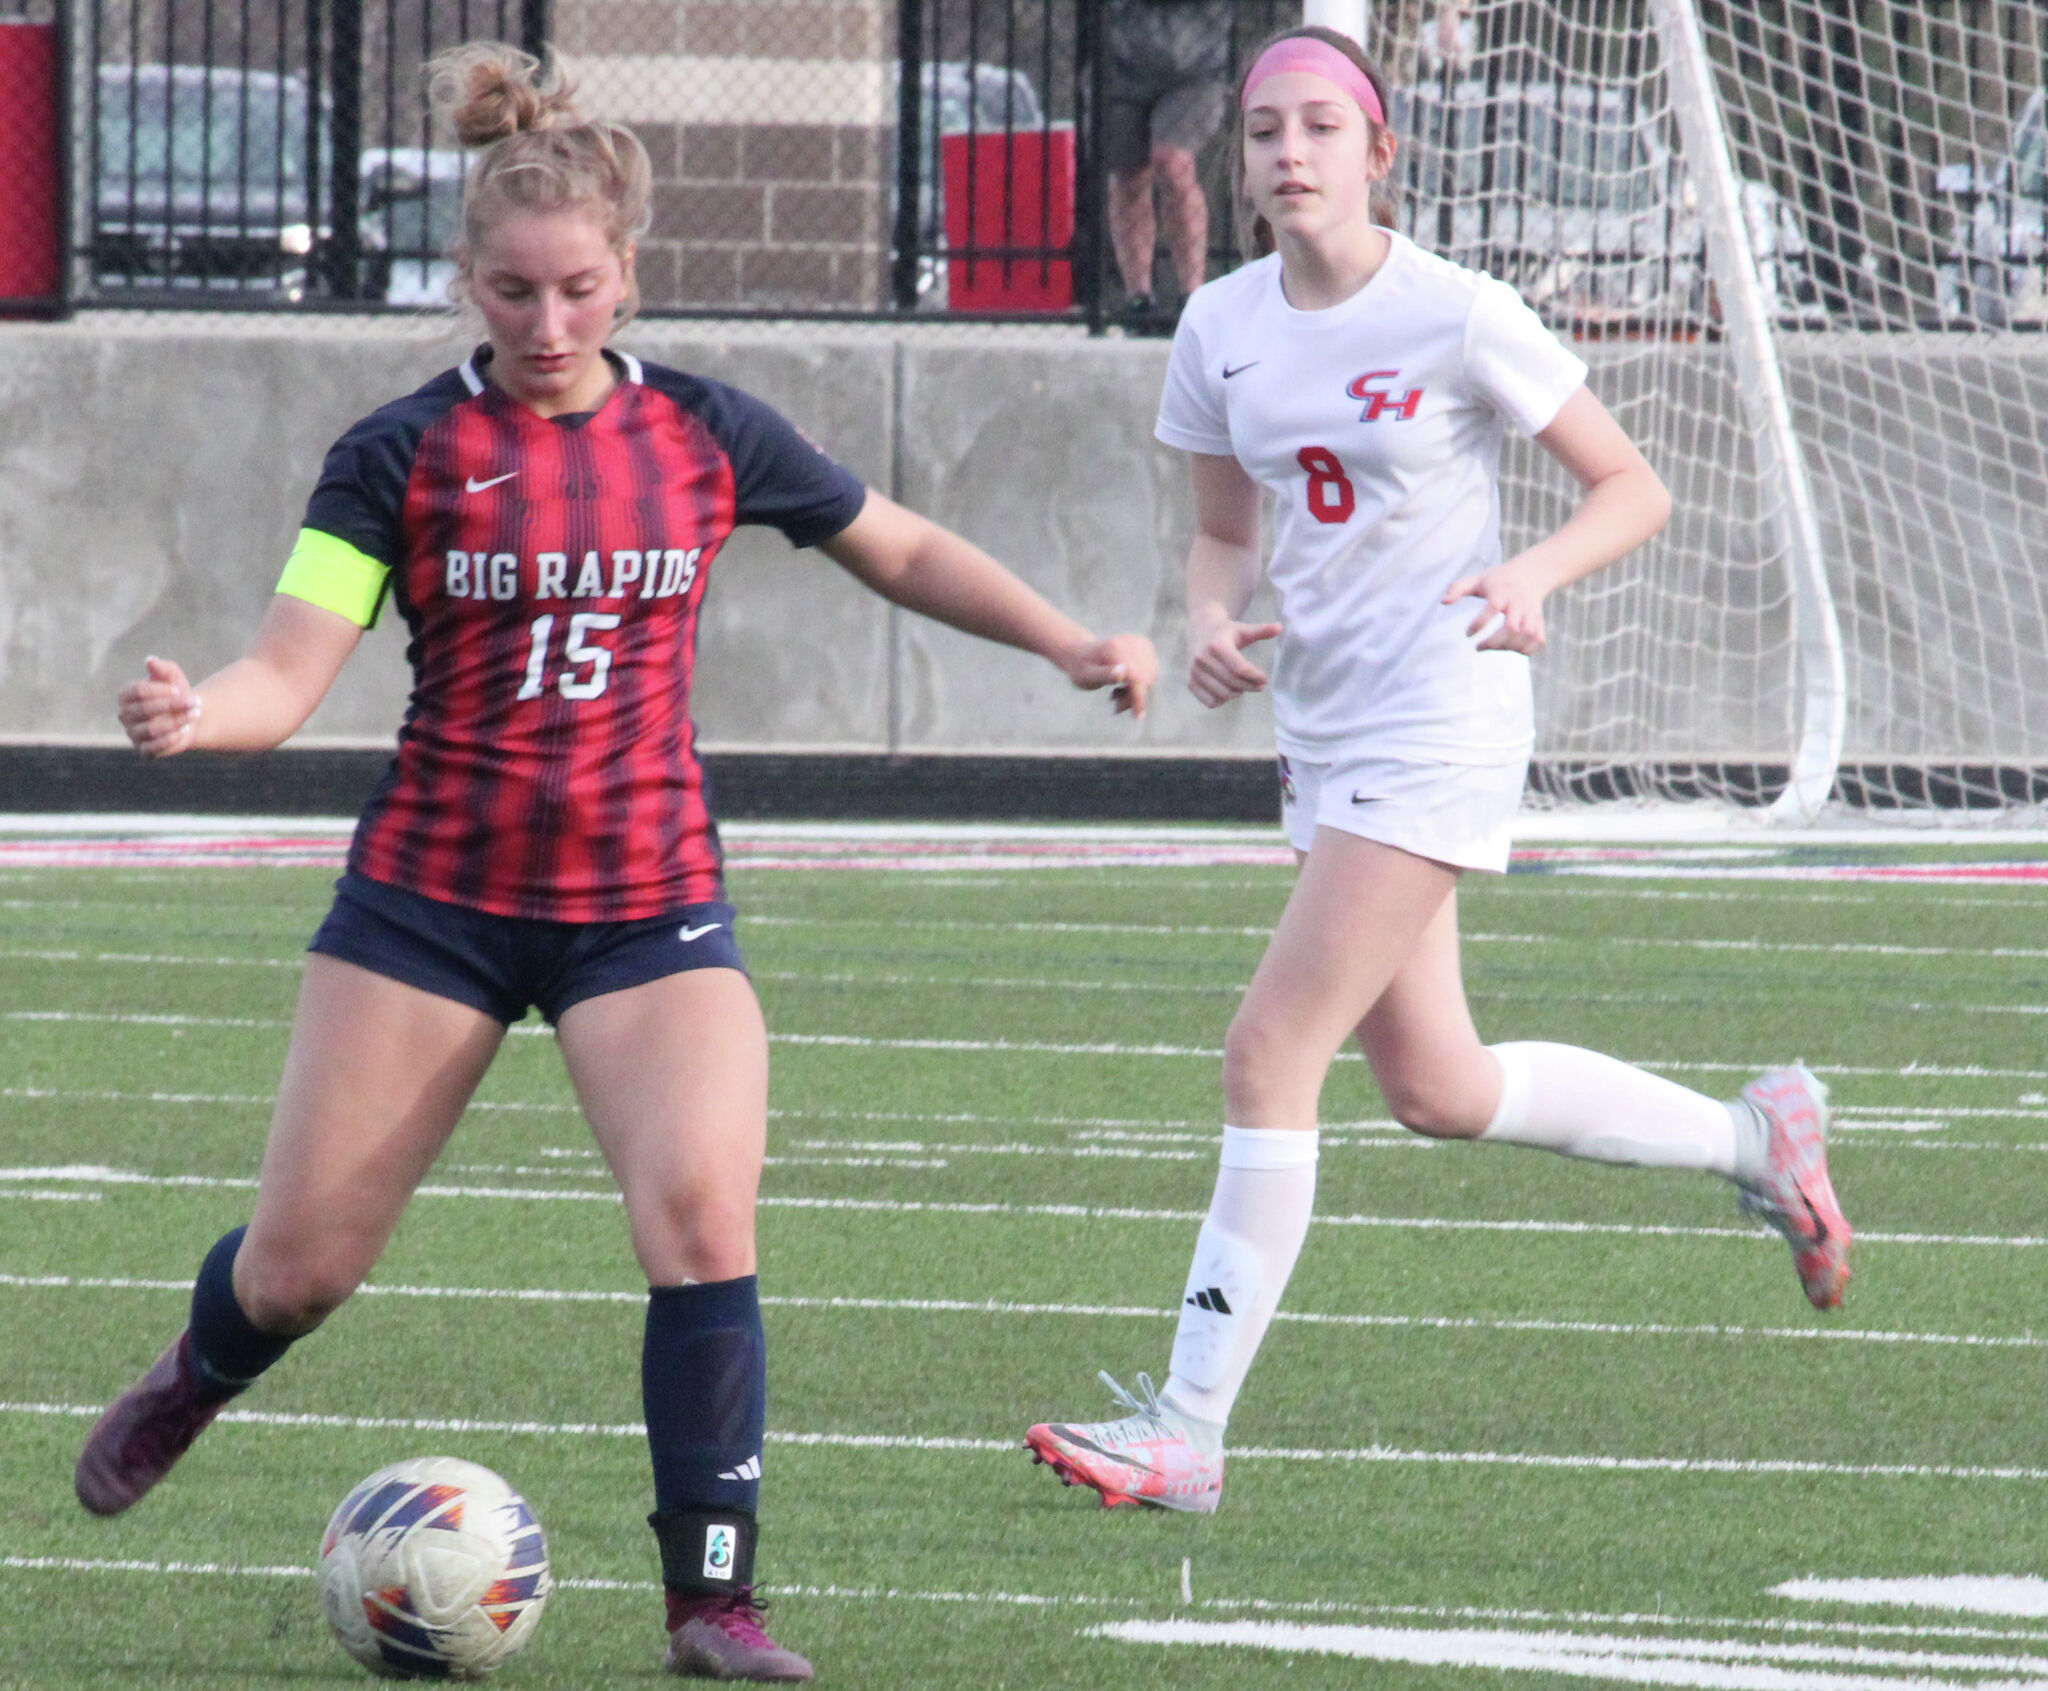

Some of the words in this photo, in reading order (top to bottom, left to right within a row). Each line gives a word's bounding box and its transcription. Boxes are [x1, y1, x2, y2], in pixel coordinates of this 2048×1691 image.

[1347, 370, 1425, 422] CH
[1297, 447, 1355, 523] 8
[447, 550, 518, 600] BIG
[535, 548, 701, 600] RAPIDS
[517, 613, 621, 700] 15
